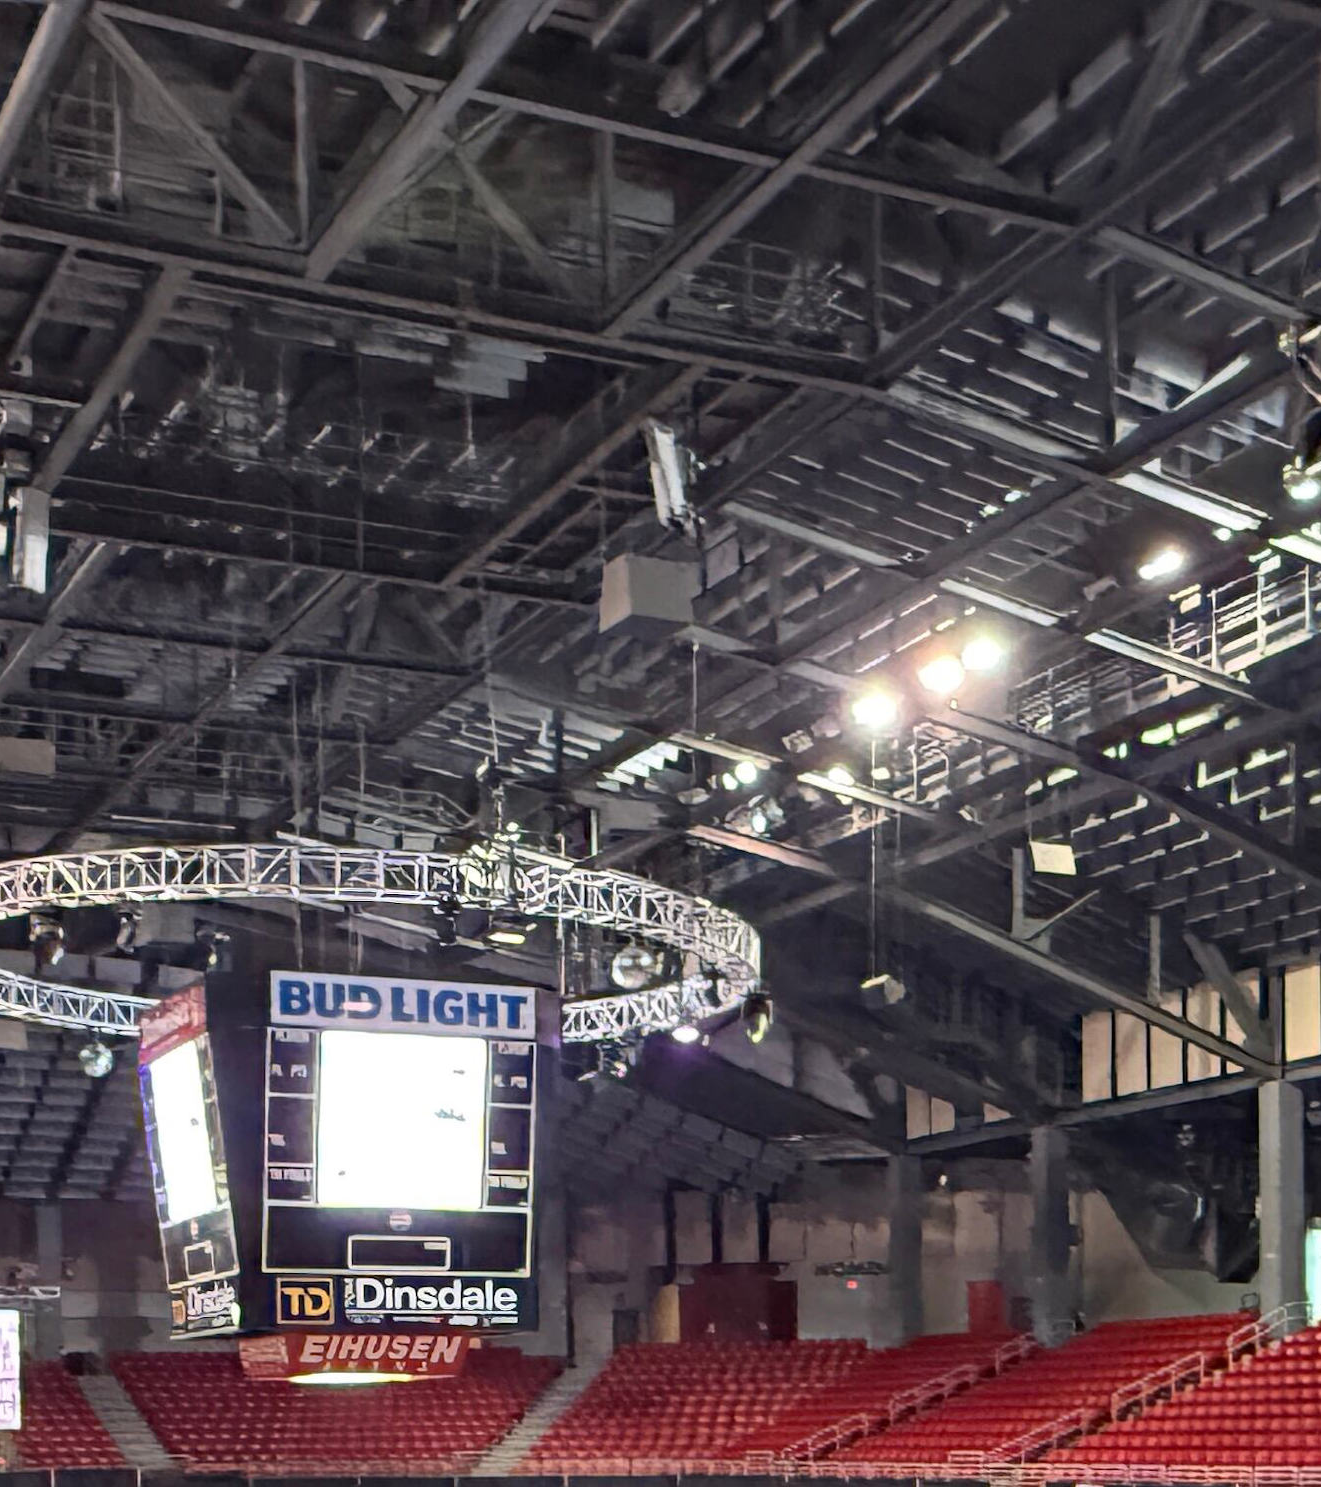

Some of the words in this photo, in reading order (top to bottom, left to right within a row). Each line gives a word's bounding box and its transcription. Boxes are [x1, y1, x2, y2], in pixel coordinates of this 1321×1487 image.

[278, 979, 382, 1020] BUD
[390, 986, 528, 1030] LIGHT
[280, 1286, 332, 1317] TD
[355, 1277, 519, 1312] Dinsdale
[299, 1334, 463, 1364] EIHUSEN
